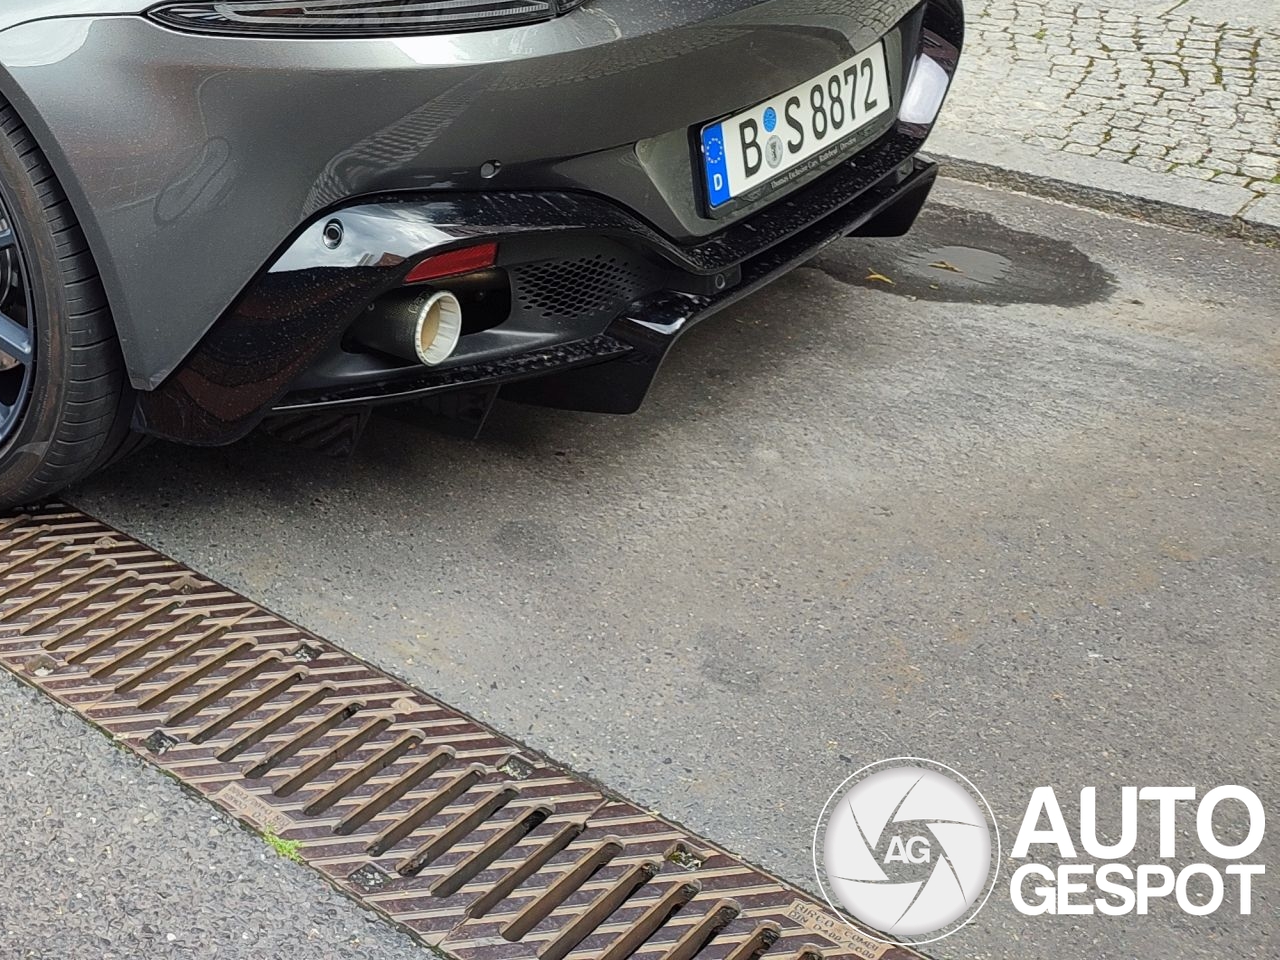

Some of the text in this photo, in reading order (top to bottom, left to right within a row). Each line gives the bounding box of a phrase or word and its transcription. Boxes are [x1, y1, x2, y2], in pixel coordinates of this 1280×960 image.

[739, 118, 762, 178] B
[713, 173, 723, 191] D
[787, 911, 809, 924] DIN
[794, 904, 880, 951] BIRCO COMBI
